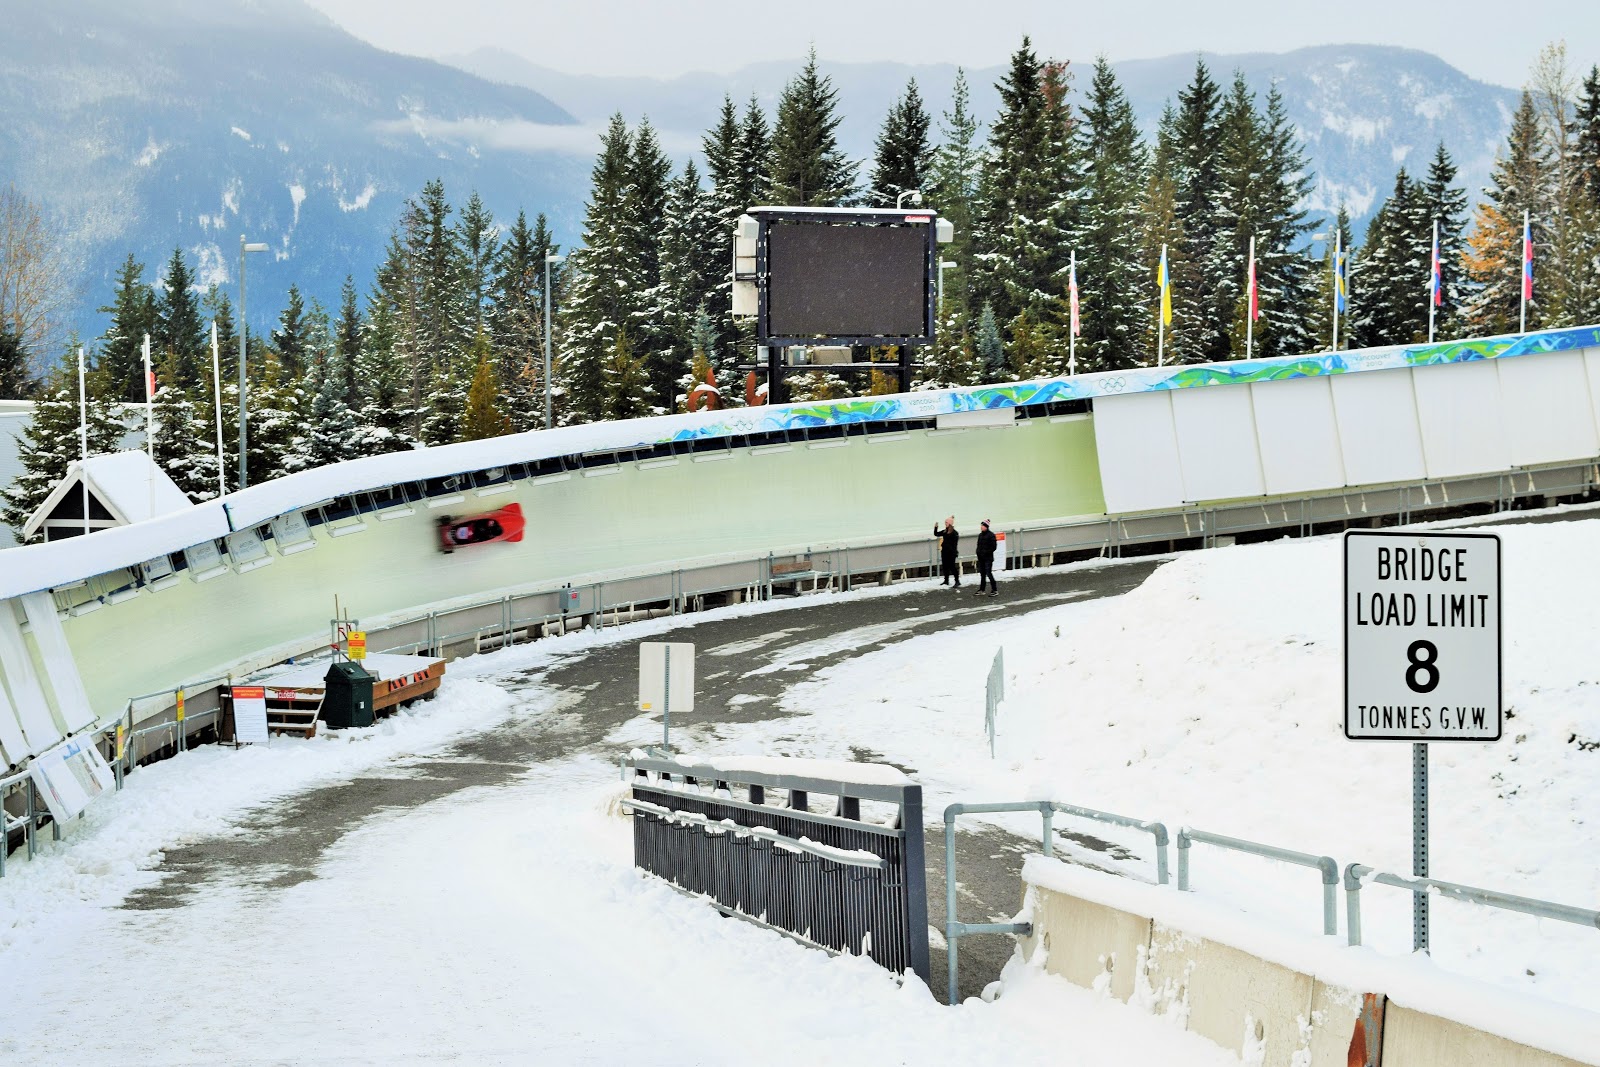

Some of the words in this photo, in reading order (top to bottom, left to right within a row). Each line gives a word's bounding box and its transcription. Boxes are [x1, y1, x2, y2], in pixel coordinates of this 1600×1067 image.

[1378, 547, 1467, 581] BRIDGE
[1357, 592, 1416, 626] LOAD
[1427, 594, 1488, 627] LIMIT
[1406, 639, 1440, 693] 8
[1358, 706, 1431, 729] TONNES
[1440, 707, 1488, 729] G.V.W.
